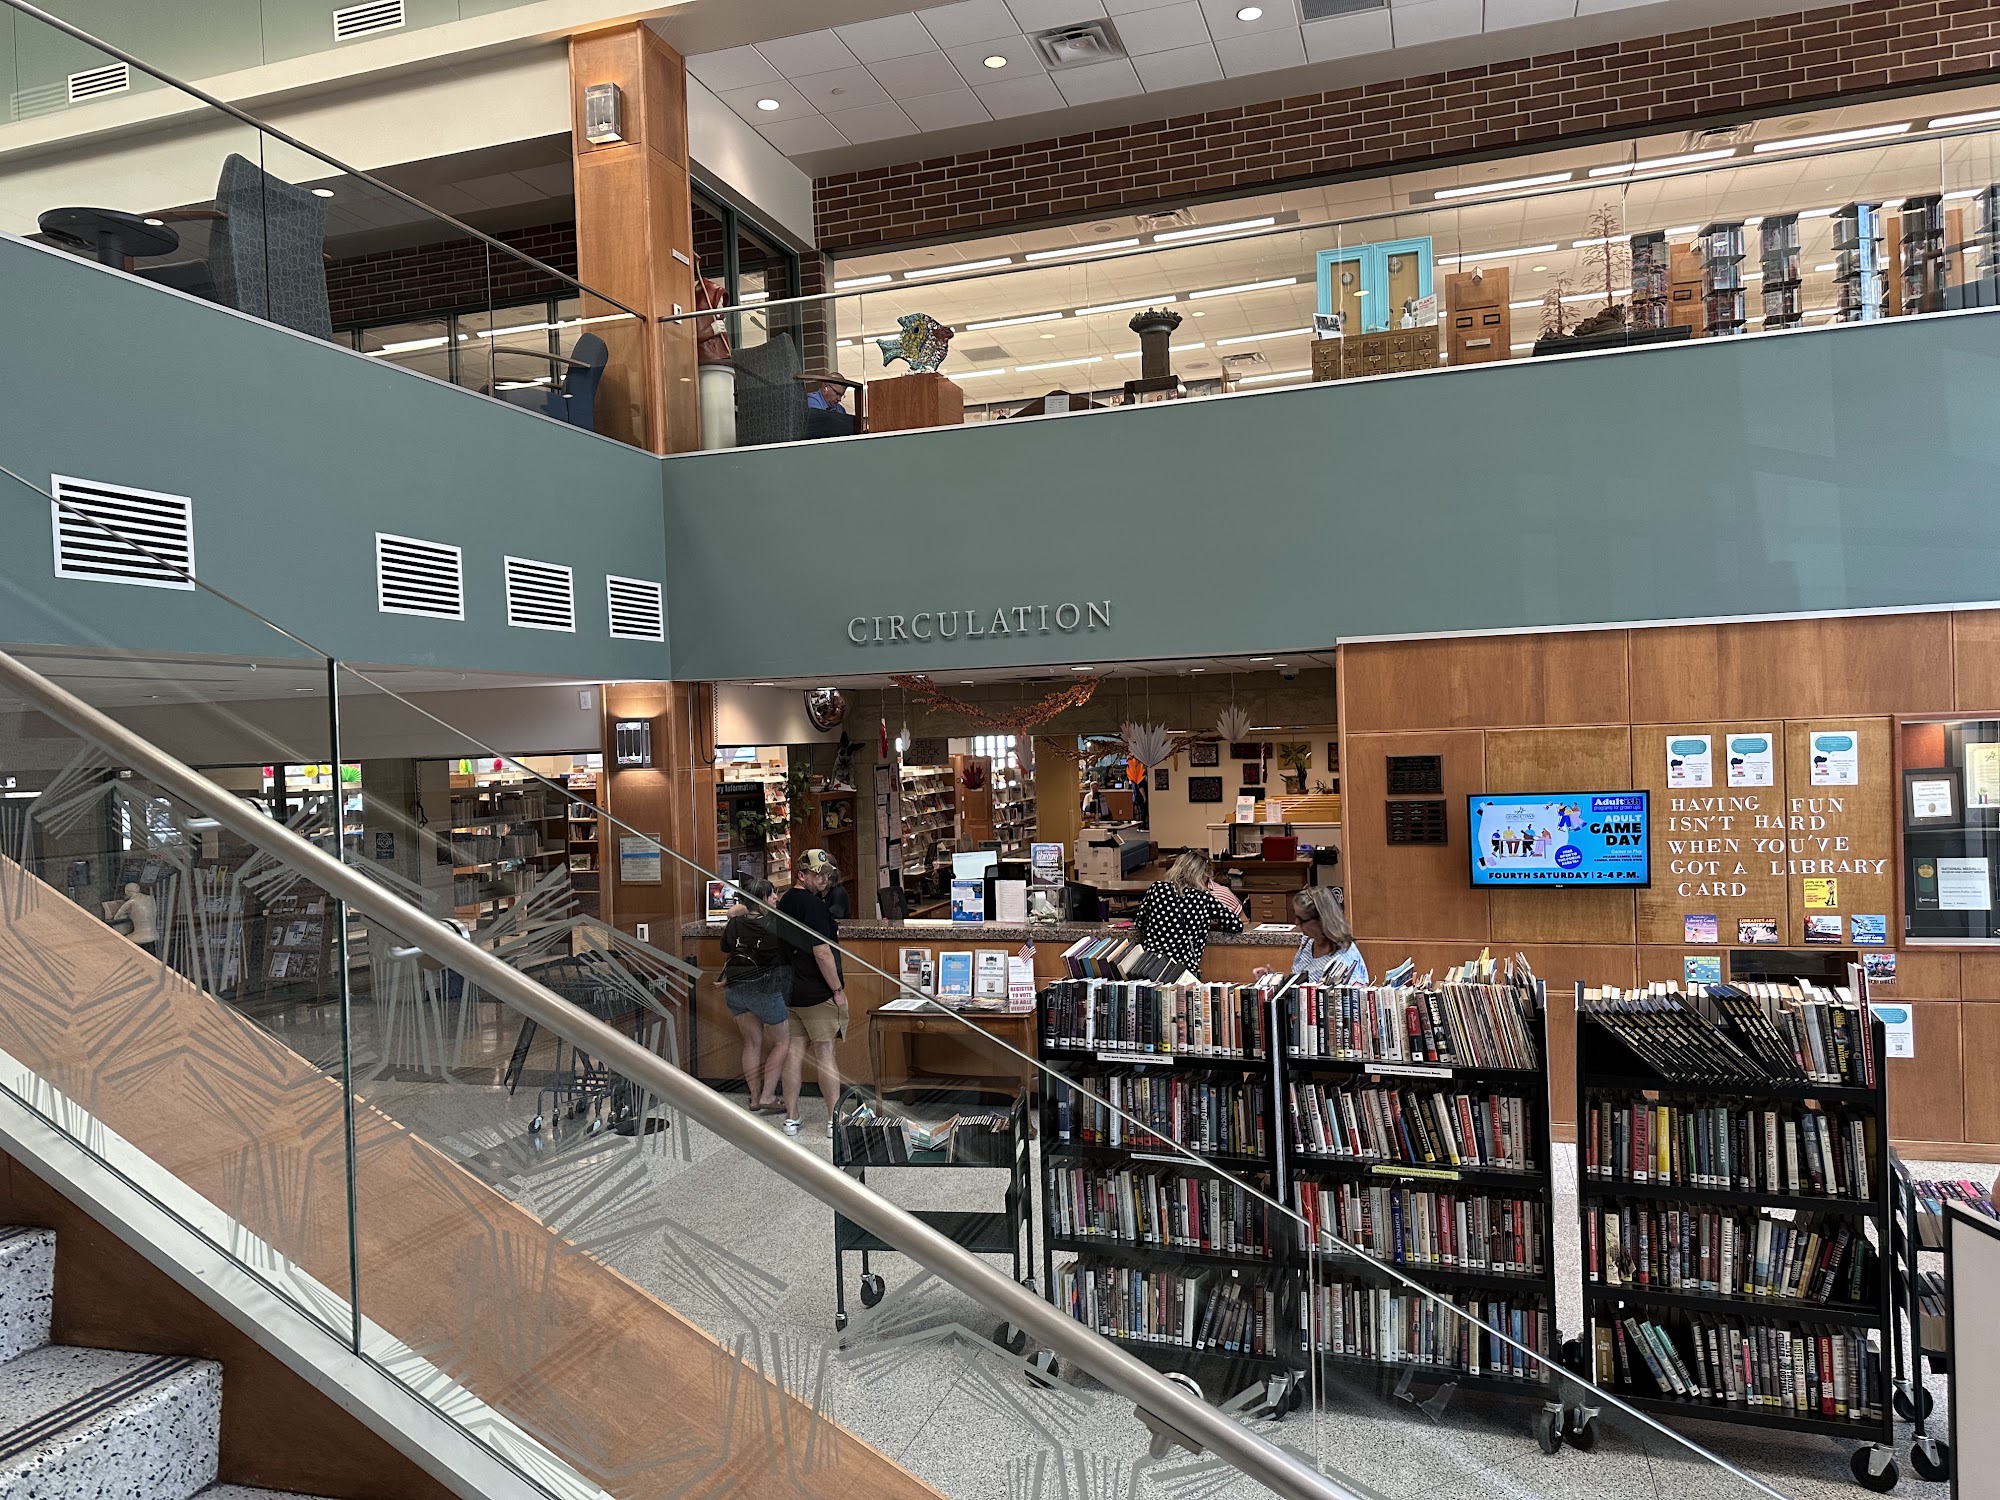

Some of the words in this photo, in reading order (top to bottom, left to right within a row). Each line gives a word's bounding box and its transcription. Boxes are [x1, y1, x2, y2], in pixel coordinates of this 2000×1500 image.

[847, 600, 1112, 642] CIRCULATION
[911, 748, 940, 756] CHECK
[916, 756, 934, 764] OUT
[725, 784, 757, 792] Information
[1594, 798, 1641, 806] Adultish
[1671, 796, 1760, 812] HAVING
[1790, 798, 1844, 814] FUN
[1604, 814, 1642, 822] ADULT
[1669, 816, 1734, 832] ISN'T
[1754, 815, 1826, 830] HARD
[1590, 822, 1642, 834] GAME
[1606, 835, 1642, 846] DAY
[1666, 838, 1741, 855] WHEN
[1751, 834, 1850, 854] YOU'VE
[1670, 860, 1720, 876] GOT
[1733, 861, 1748, 875] A
[1770, 859, 1888, 876] LIBRARY
[1677, 882, 1747, 897] CARD
[1429, 997, 1442, 1025] LEGENDS
[1837, 1044, 1847, 1073] NAVIGATOR
[1463, 1116, 1471, 1137] CHANGE
[1766, 1115, 1774, 1128] Mary
[1361, 1196, 1370, 1208] US
[1362, 1213, 1372, 1236] THEM
[1682, 1214, 1690, 1226] OUT
[1682, 1227, 1690, 1236] OF
[1682, 1236, 1690, 1253] REACH
[1778, 1332, 1786, 1357] CUSSLER
[1807, 1337, 1815, 1352] CLIVE
[1808, 1352, 1816, 1374] CUSSLER
[1822, 1353, 1830, 1373] CUSSLER
